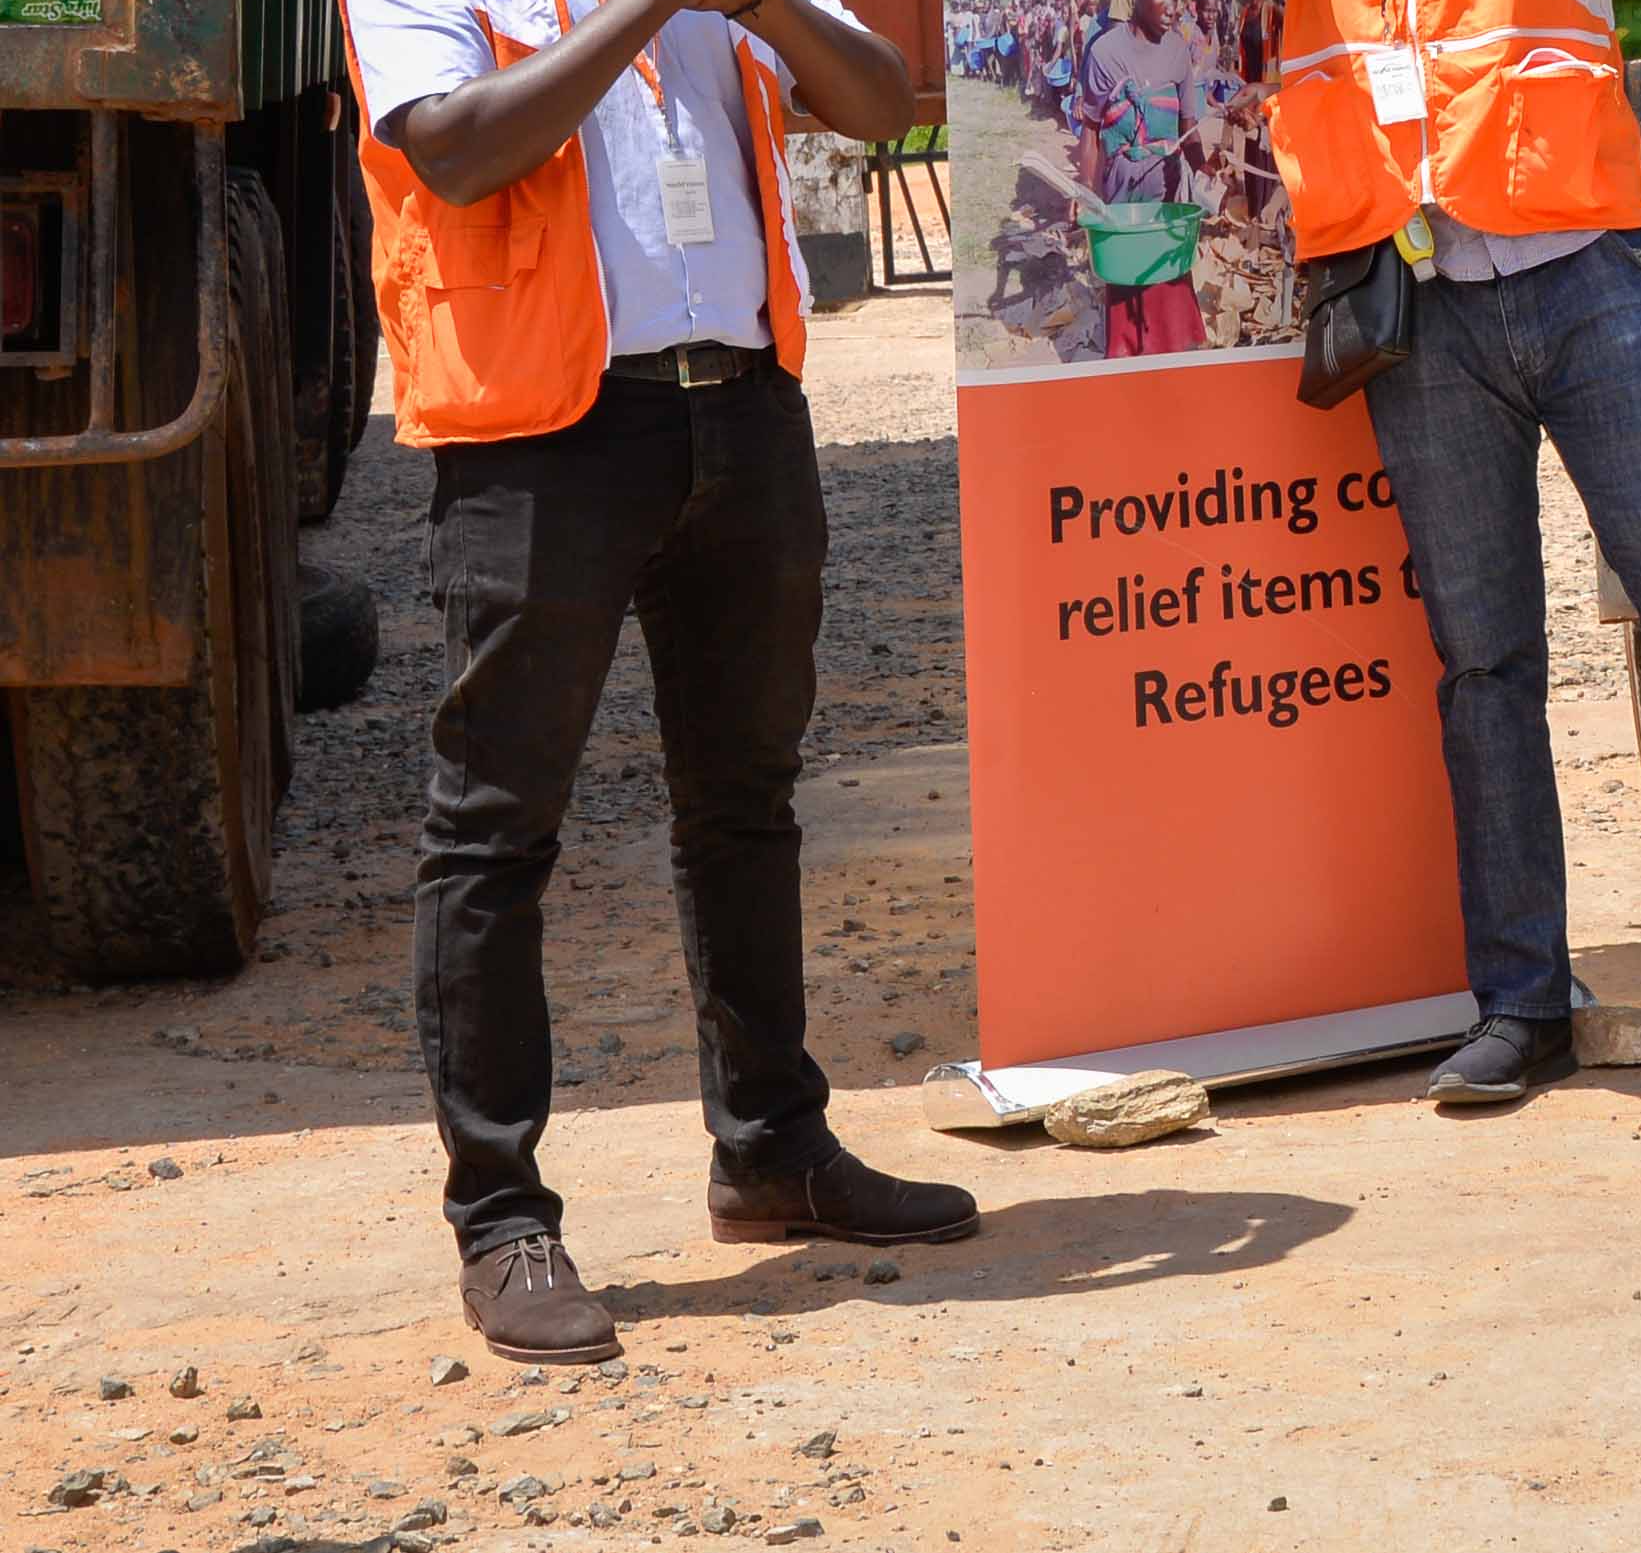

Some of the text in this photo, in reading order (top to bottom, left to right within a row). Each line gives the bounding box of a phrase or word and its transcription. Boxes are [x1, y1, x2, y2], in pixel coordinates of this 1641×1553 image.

[1050, 468, 1318, 543] Providing
[1058, 568, 1203, 640] relief
[1222, 563, 1381, 620] items
[1134, 658, 1390, 728] Refugees
